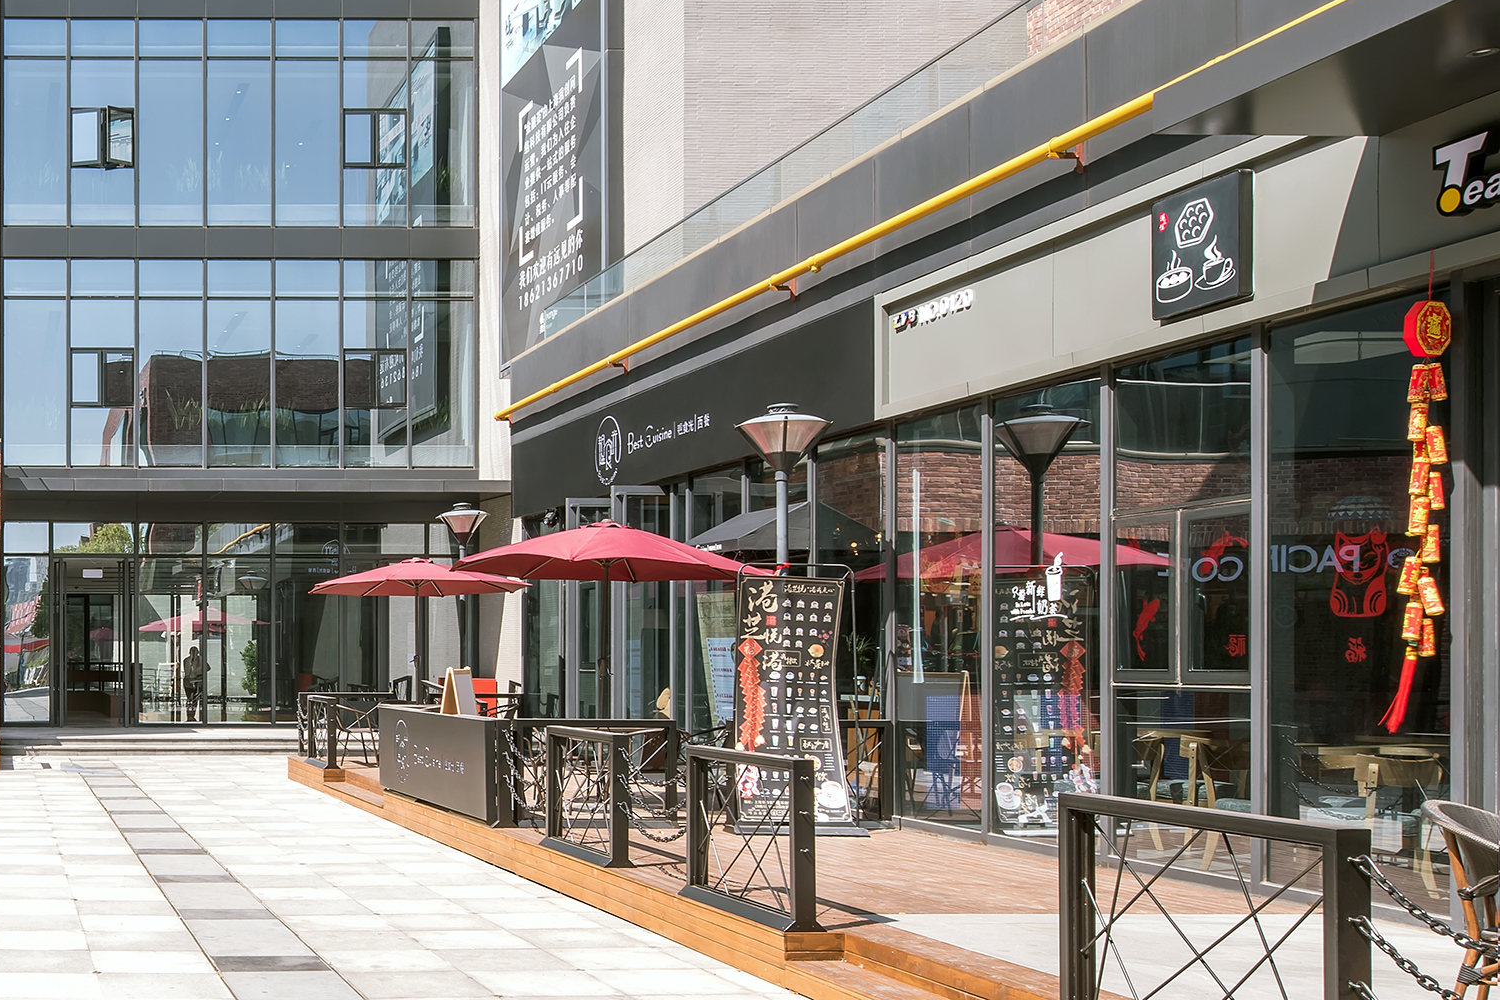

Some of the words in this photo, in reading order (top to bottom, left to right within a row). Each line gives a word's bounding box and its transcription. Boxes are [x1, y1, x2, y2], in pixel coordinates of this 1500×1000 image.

[519, 228, 583, 290] 我们欢迎有远见的你
[519, 254, 583, 311] 18621367710
[627, 431, 644, 455] Best
